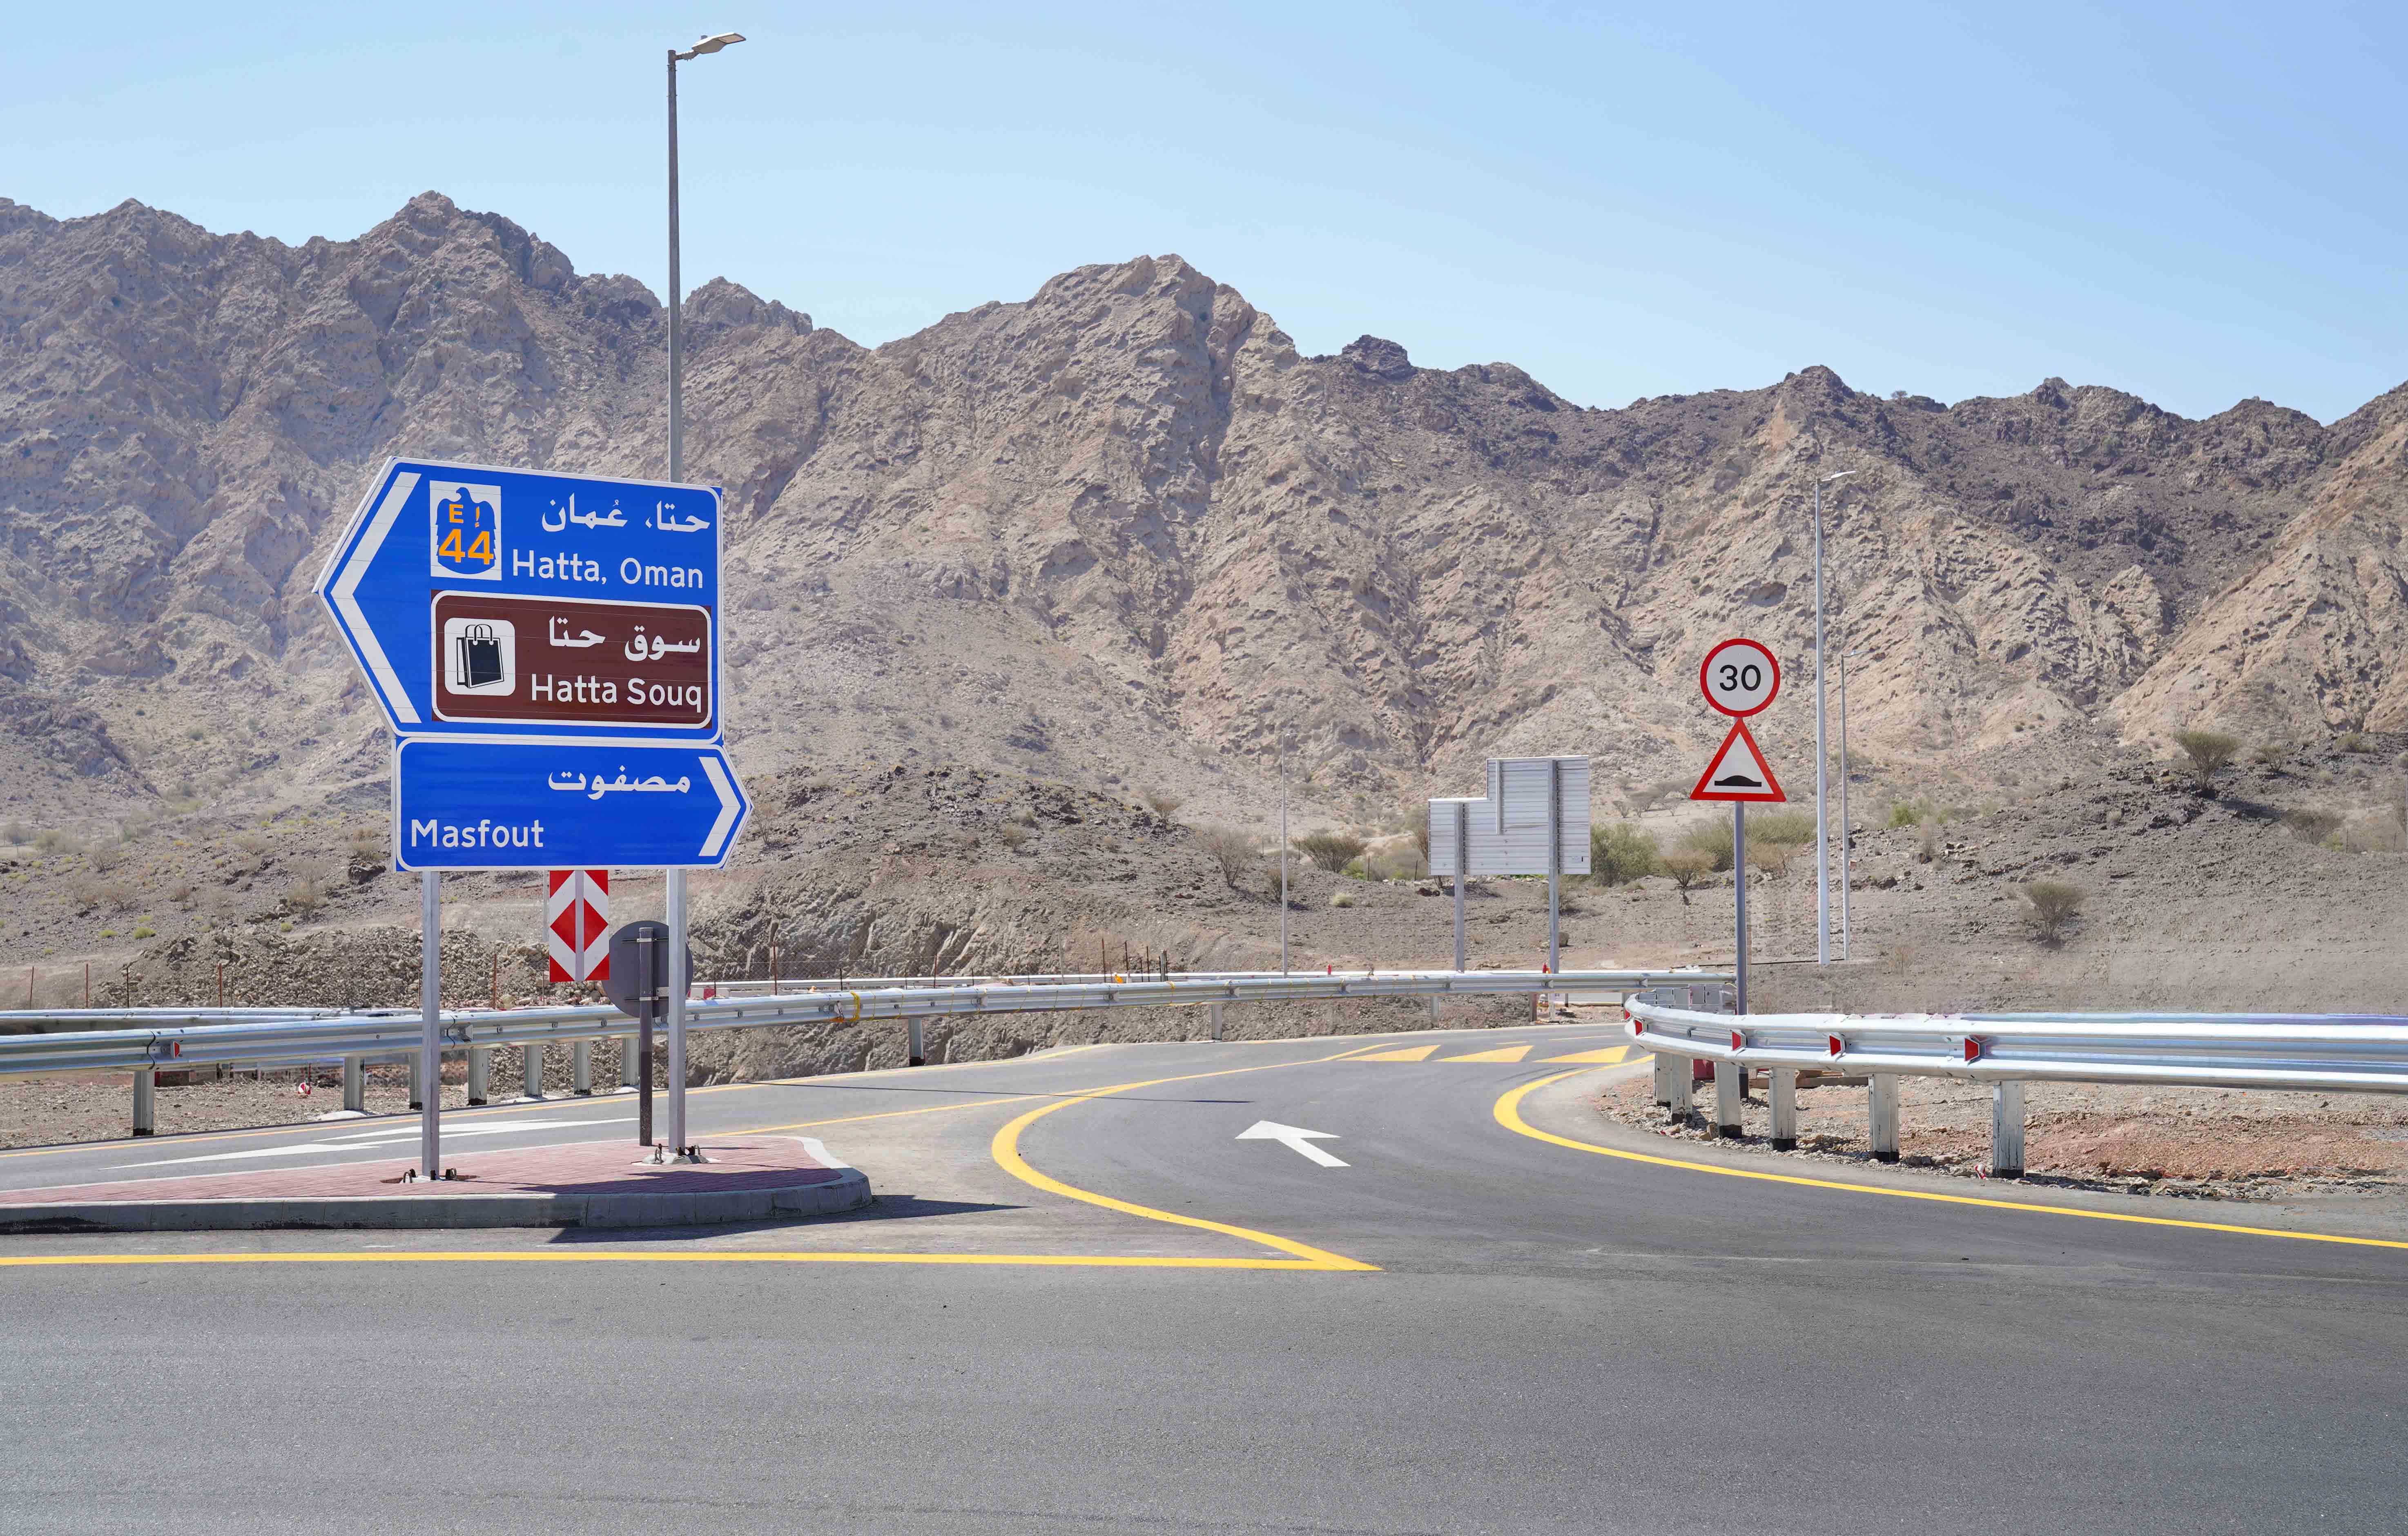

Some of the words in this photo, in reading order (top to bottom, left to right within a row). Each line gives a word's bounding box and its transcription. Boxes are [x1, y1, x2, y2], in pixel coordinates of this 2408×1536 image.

[449, 504, 464, 524] E
[439, 528, 494, 565] 44
[513, 549, 607, 585] Hatta,
[620, 557, 703, 589] Oman
[548, 615, 606, 648] حتا
[624, 625, 701, 662] سوق
[531, 673, 618, 704] Hatta
[627, 677, 702, 714] Souq
[1719, 664, 1761, 691] 30
[548, 765, 691, 800] مصفوت
[411, 819, 544, 848] Masfout
